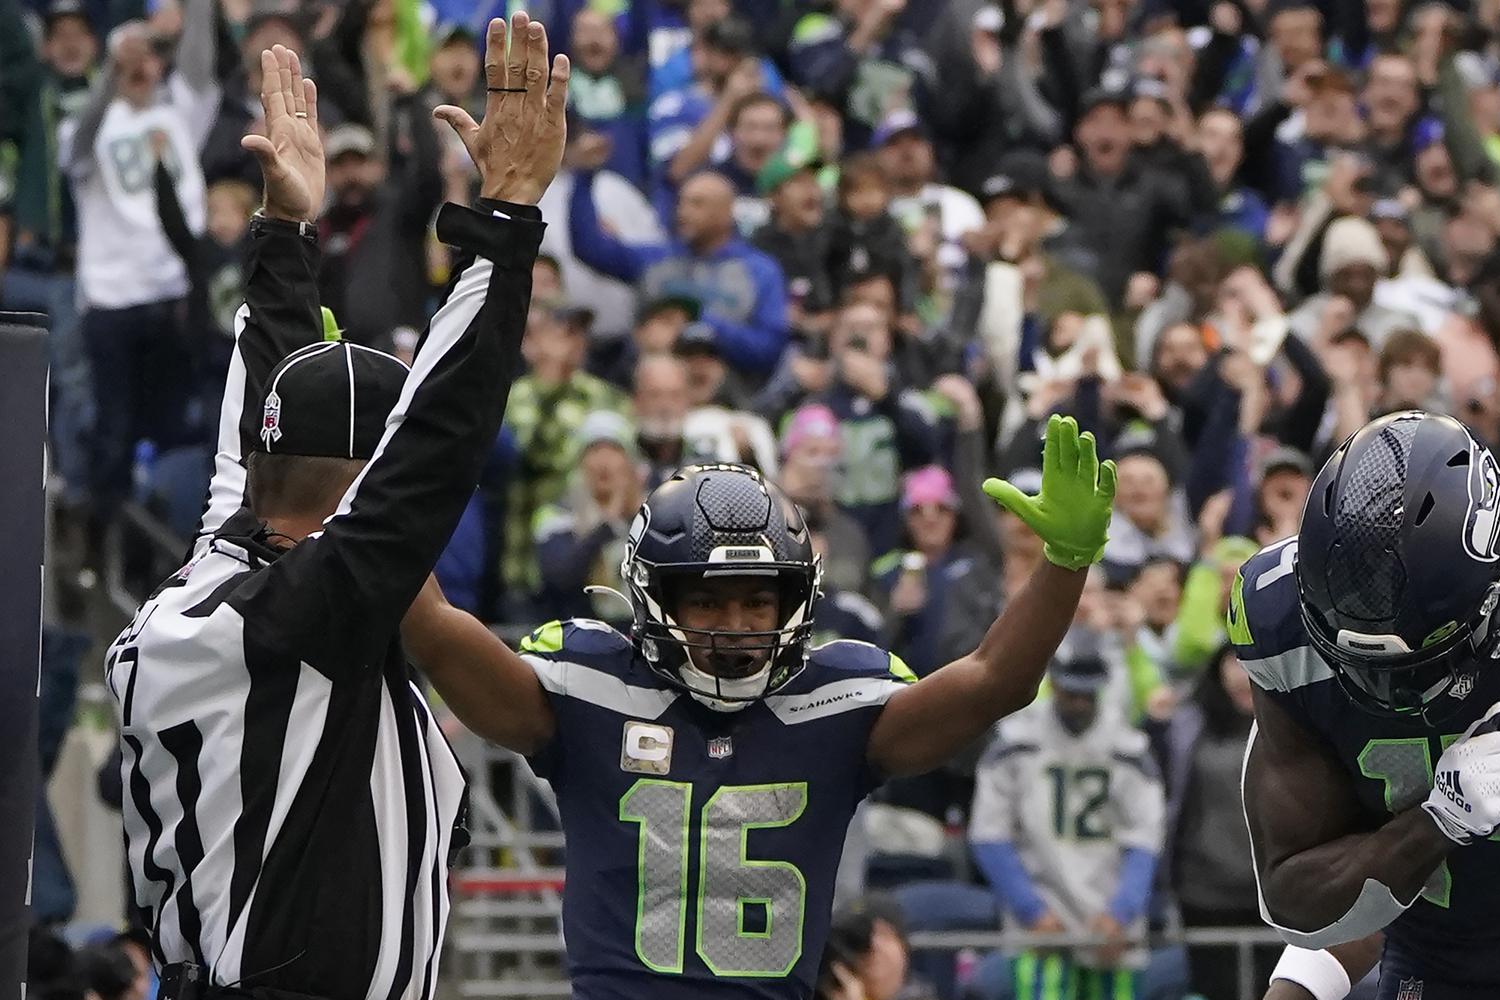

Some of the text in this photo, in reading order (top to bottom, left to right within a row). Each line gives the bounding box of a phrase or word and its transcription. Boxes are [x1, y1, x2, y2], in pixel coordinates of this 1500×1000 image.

[626, 725, 671, 761] C
[1045, 765, 1112, 838] 12
[1435, 772, 1472, 814] adidas
[619, 778, 808, 977] 16
